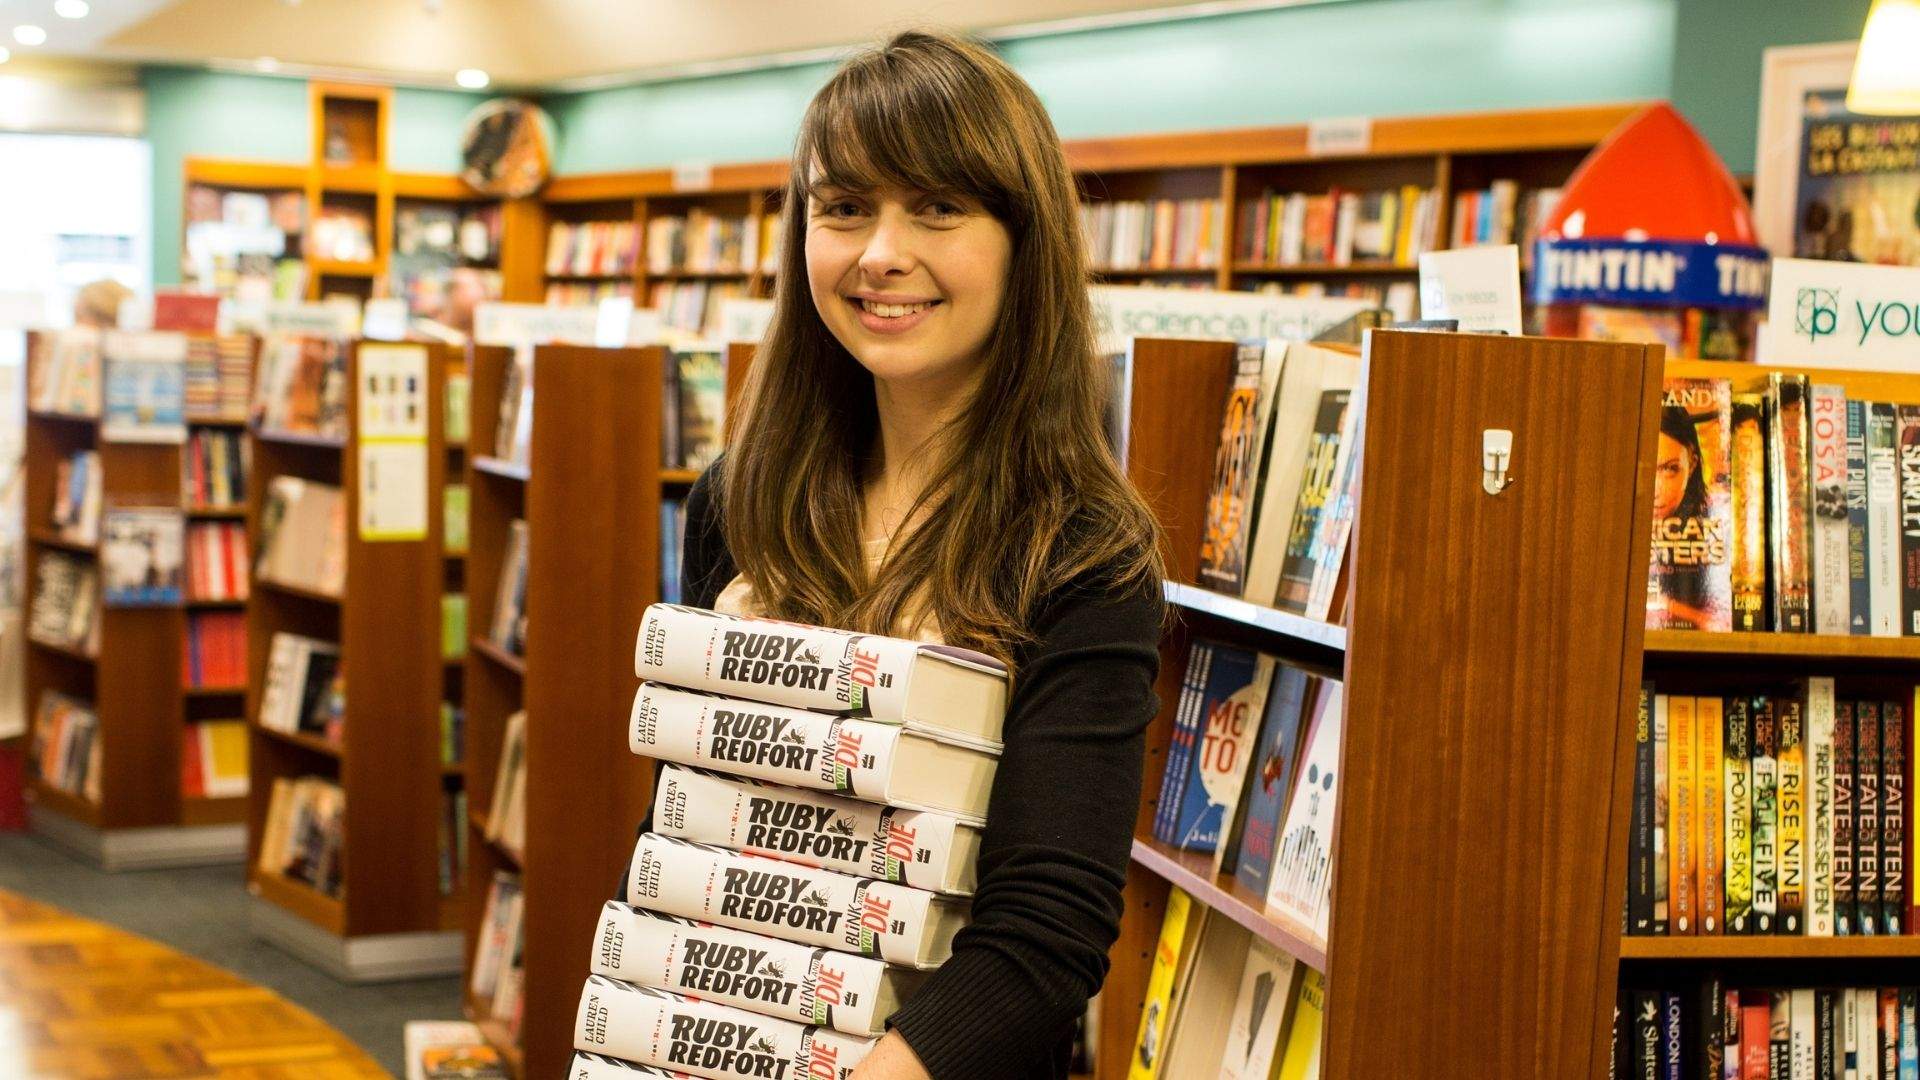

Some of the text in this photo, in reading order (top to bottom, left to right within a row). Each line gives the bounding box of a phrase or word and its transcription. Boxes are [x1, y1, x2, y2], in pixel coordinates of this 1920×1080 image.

[1548, 248, 1676, 292] TINTIN
[1121, 302, 1249, 336] science
[1855, 299, 1920, 346] yo
[1815, 397, 1834, 482] ROSA
[1871, 447, 1896, 504] HOOD
[645, 617, 659, 666] LAUREN
[654, 628, 667, 667] CHILD
[722, 630, 806, 663] RUBY
[720, 657, 834, 692] REDFORT
[852, 683, 863, 704] YOU
[637, 695, 652, 744] LAUREN
[647, 707, 659, 745] CHILD
[712, 710, 792, 743] RUBY
[1204, 697, 1249, 739] ME
[1729, 714, 1738, 747] LORE
[1738, 701, 1747, 758] PITTACUS
[1755, 714, 1765, 746] LORE
[1764, 701, 1773, 758] PITTACUS
[1782, 714, 1791, 747] LORE
[710, 736, 819, 772] REDFORT
[836, 764, 847, 783] YOU
[1203, 733, 1237, 774] TO
[663, 779, 678, 828] LAUREN
[674, 791, 687, 830] CHILD
[1815, 752, 1830, 838] REVENGE
[1834, 774, 1851, 829] FATE
[1860, 774, 1877, 829] FATE
[1885, 774, 1902, 829] FATE
[748, 797, 837, 834] RUBY
[1731, 771, 1746, 879] POWER SIX
[746, 824, 869, 863] REDFORT
[1783, 774, 1800, 906] RISE NINE
[637, 847, 653, 898] LAUREN
[648, 860, 662, 899] CHILD
[723, 867, 812, 904] RUBY
[887, 860, 899, 881] YOU
[1755, 843, 1773, 905] FIVE
[1815, 850, 1830, 915] SEVEN
[1834, 842, 1851, 891] TEN
[1860, 842, 1877, 891] TEN
[1885, 842, 1902, 891] TEN
[1677, 874, 1689, 912] FOUR
[1704, 874, 1715, 912] FOUR
[720, 894, 843, 934] REDFORT
[600, 919, 616, 968] LAUREN
[611, 931, 625, 970] CHILD
[682, 938, 769, 975] RUBY
[862, 928, 873, 950] YOU
[679, 965, 798, 1006] REDFORT
[584, 994, 600, 1043] LAUREN
[595, 1006, 609, 1045] CHILD
[815, 1000, 826, 1021] YOU
[1669, 997, 1680, 1064] LONDON
[670, 1013, 759, 1051] RUBY
[667, 1041, 791, 1080] REDFORT
